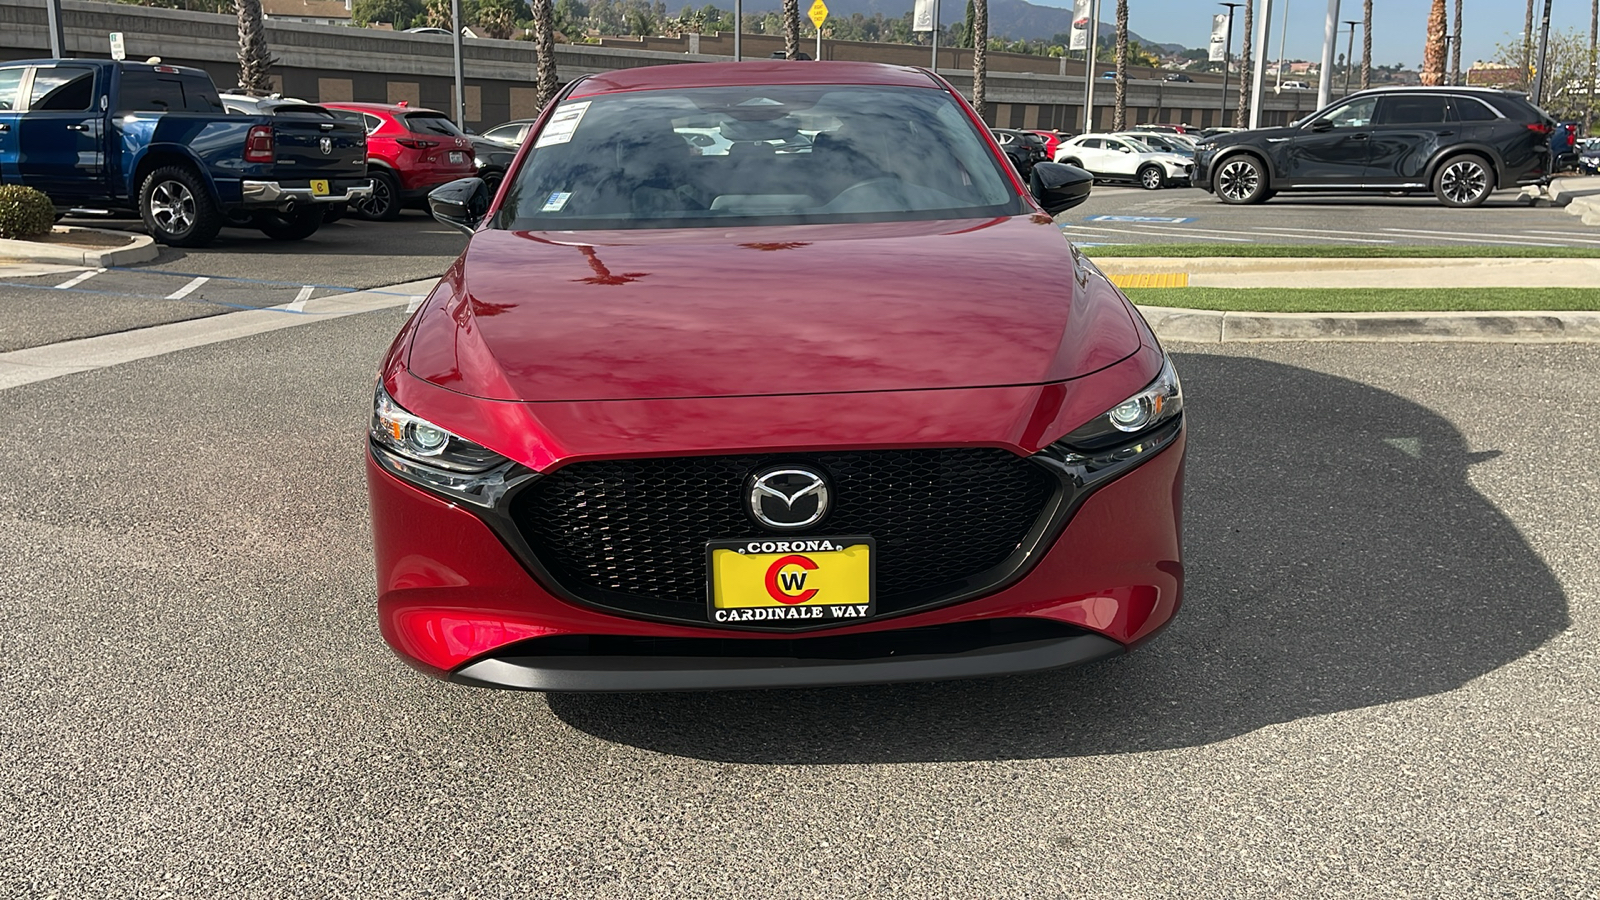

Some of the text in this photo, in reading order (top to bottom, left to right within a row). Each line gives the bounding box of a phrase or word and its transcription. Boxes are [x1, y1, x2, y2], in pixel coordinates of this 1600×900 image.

[747, 540, 834, 553] CORONA
[715, 605, 869, 622] CARDINALE WAY
